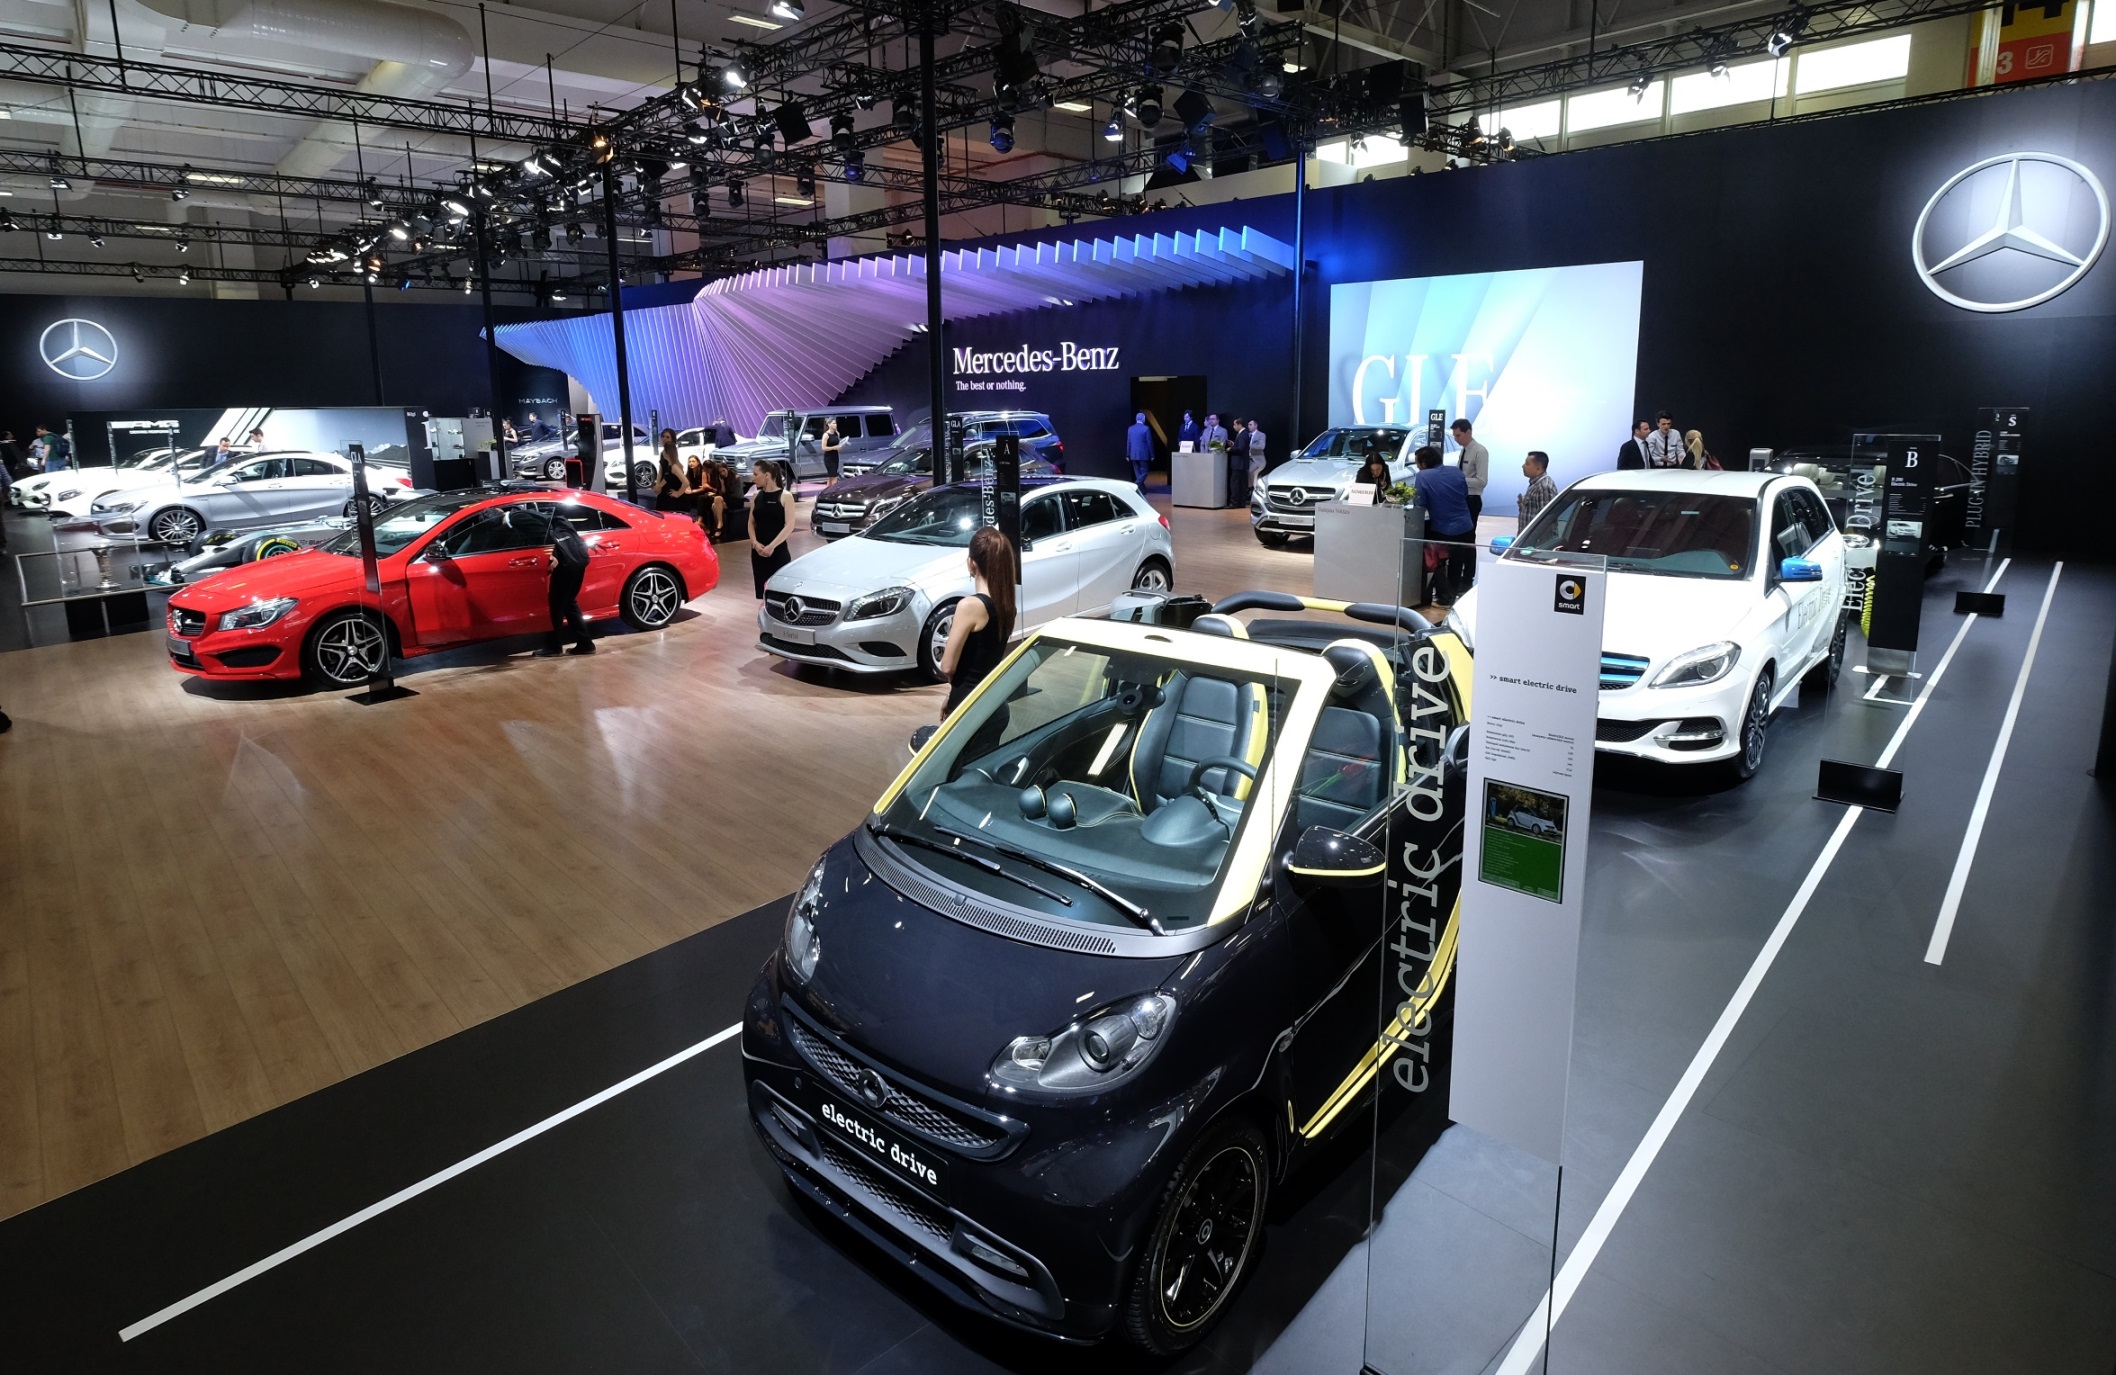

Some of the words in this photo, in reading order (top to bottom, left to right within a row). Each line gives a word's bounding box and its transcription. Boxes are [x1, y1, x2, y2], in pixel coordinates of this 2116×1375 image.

[953, 341, 1119, 375] Mercedes-Benz
[956, 381, 969, 391] The
[970, 380, 985, 391] best
[987, 383, 994, 391] or
[995, 380, 1026, 392] nothing.
[1430, 413, 1443, 421] GLE
[1905, 451, 1918, 468] B
[1972, 430, 1992, 476] HYBRID
[1846, 474, 1876, 529] Drive
[1558, 602, 1580, 610] smart
[1499, 676, 1521, 684] smart
[1523, 680, 1554, 690] electric
[1556, 684, 1577, 693] drive
[1393, 646, 1450, 822] drive
[1382, 842, 1441, 1093] electric
[822, 1103, 885, 1153] electric
[890, 1143, 937, 1185] drive
